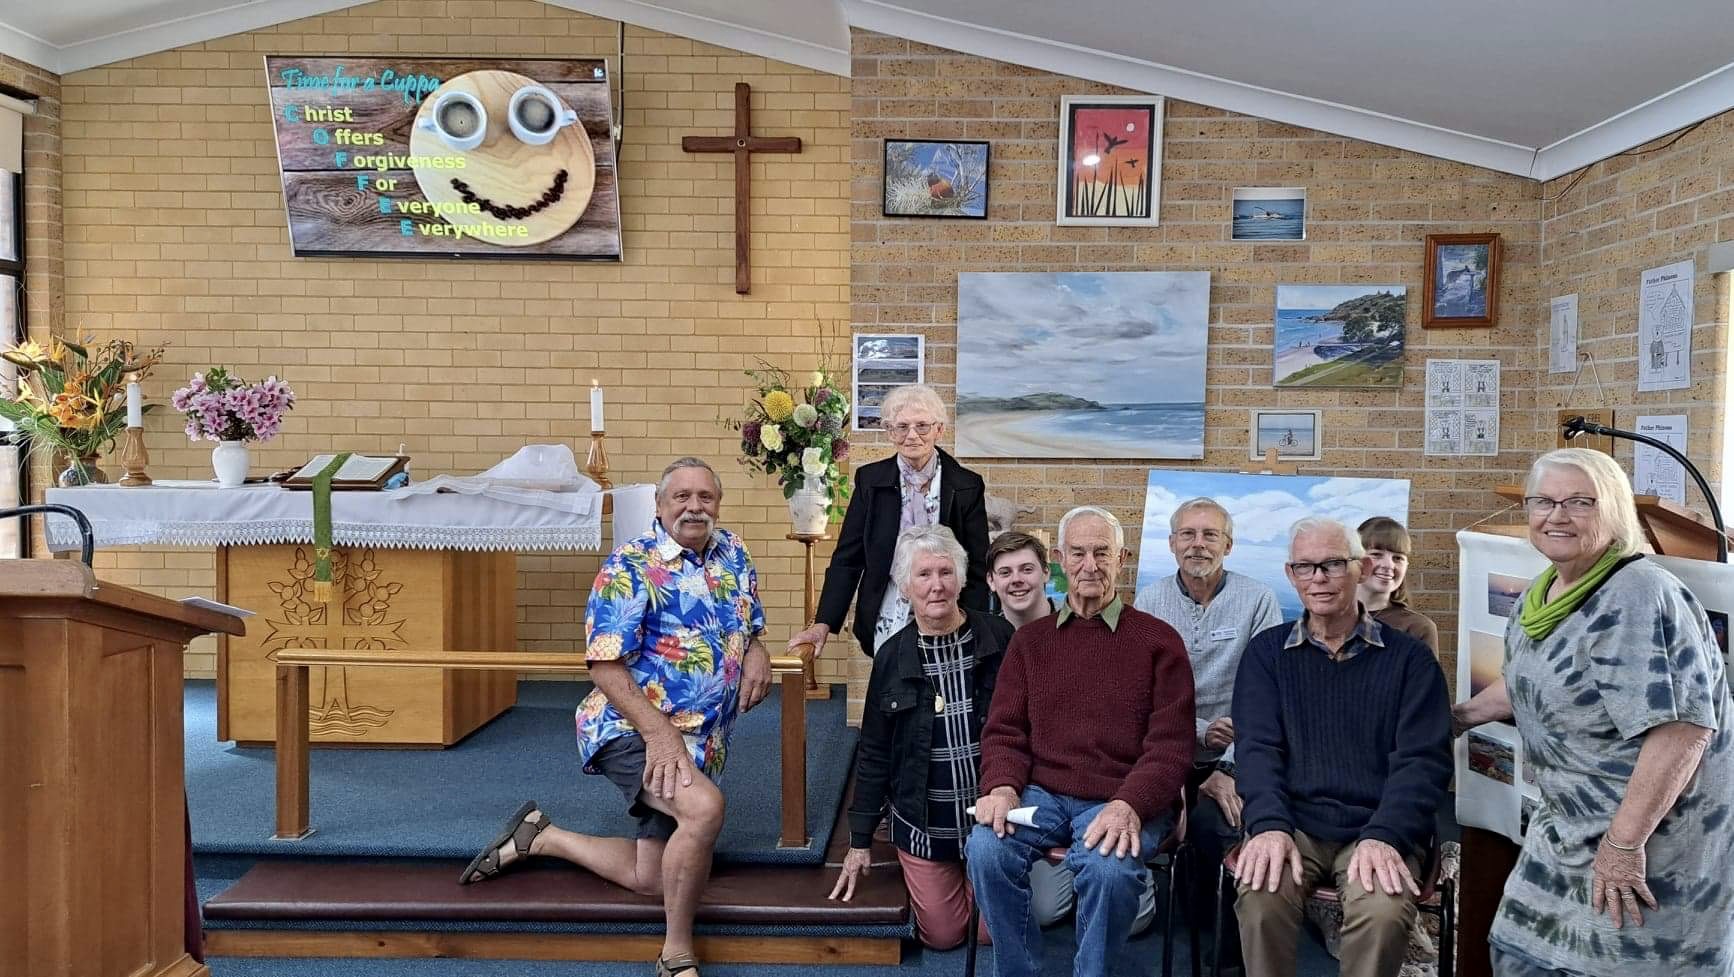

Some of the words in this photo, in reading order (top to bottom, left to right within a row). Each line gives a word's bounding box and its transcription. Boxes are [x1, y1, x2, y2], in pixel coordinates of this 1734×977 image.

[281, 68, 329, 90] Time
[332, 64, 359, 96] for
[364, 77, 376, 91] a
[380, 69, 440, 104] Cuppa
